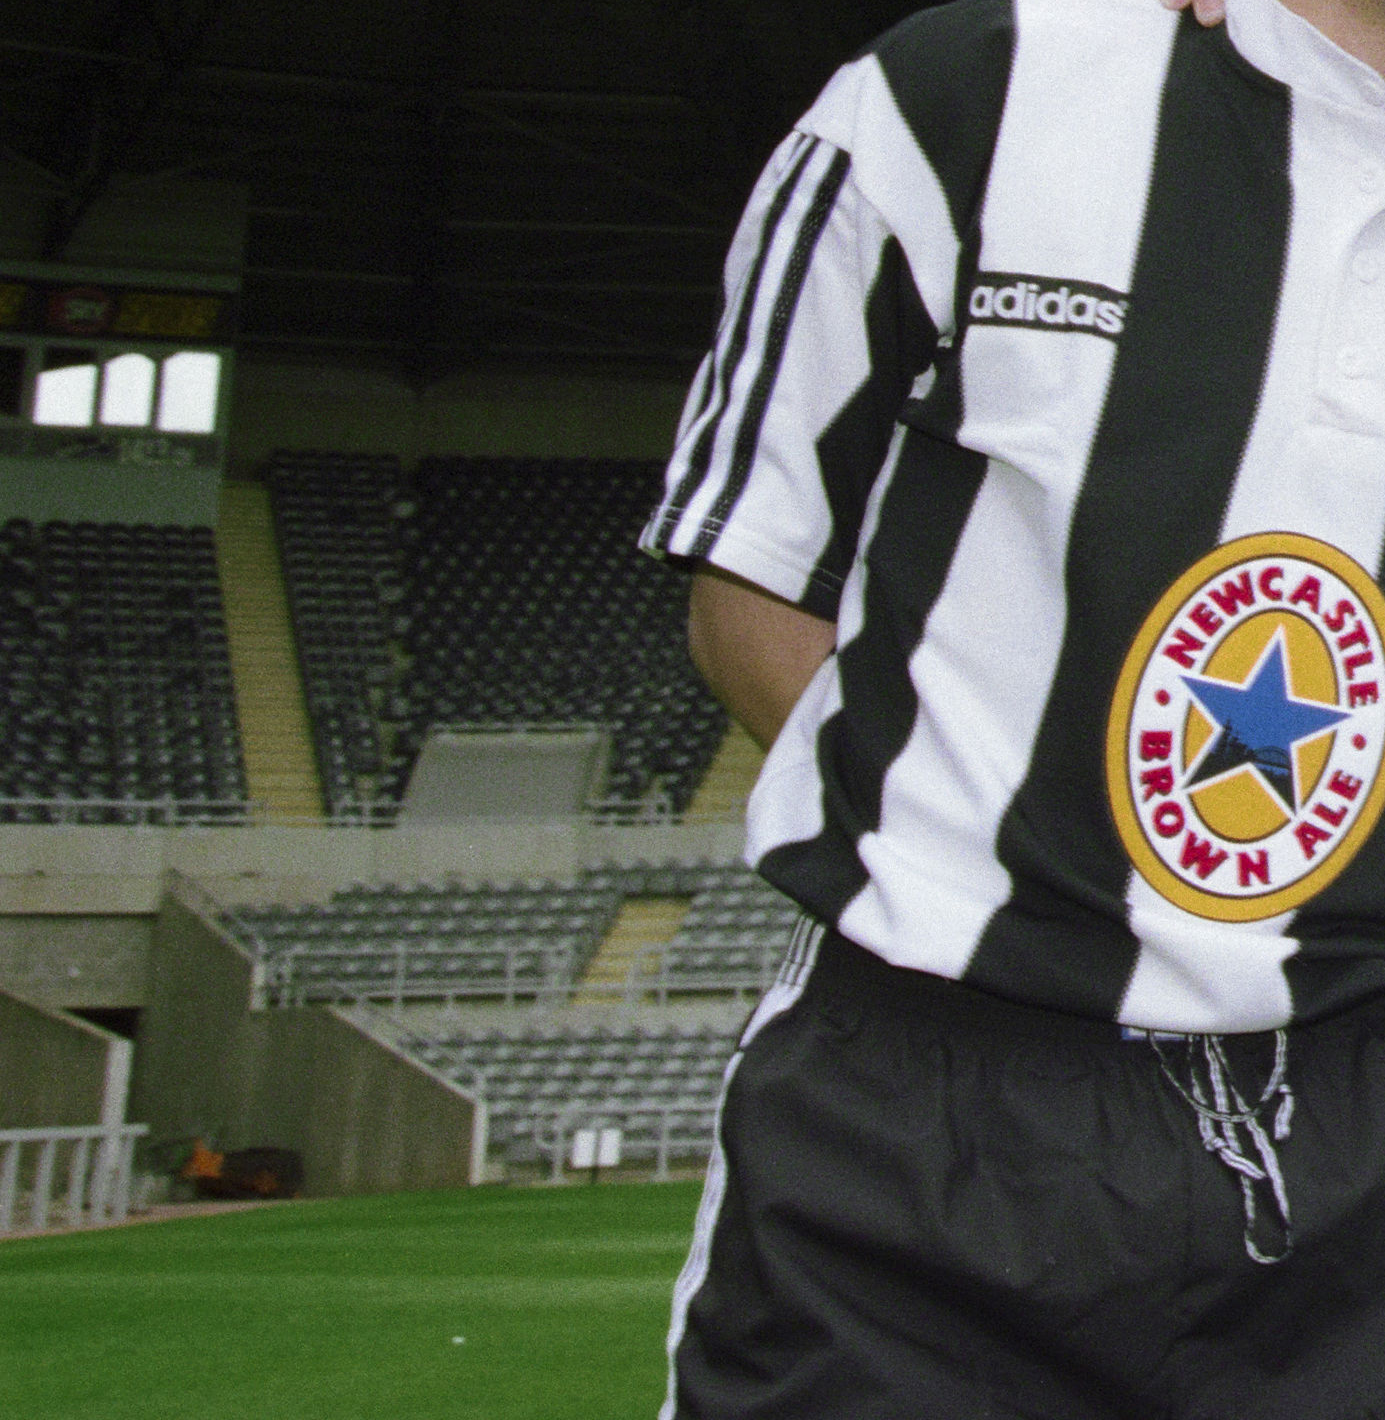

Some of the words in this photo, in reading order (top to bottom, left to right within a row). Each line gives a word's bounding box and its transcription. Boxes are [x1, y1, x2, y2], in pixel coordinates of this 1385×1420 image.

[969, 282, 1126, 334] adidas
[1162, 565, 1380, 707] NEWCASTLE
[1139, 729, 1271, 887] BROWN
[1294, 772, 1362, 860] ALE
